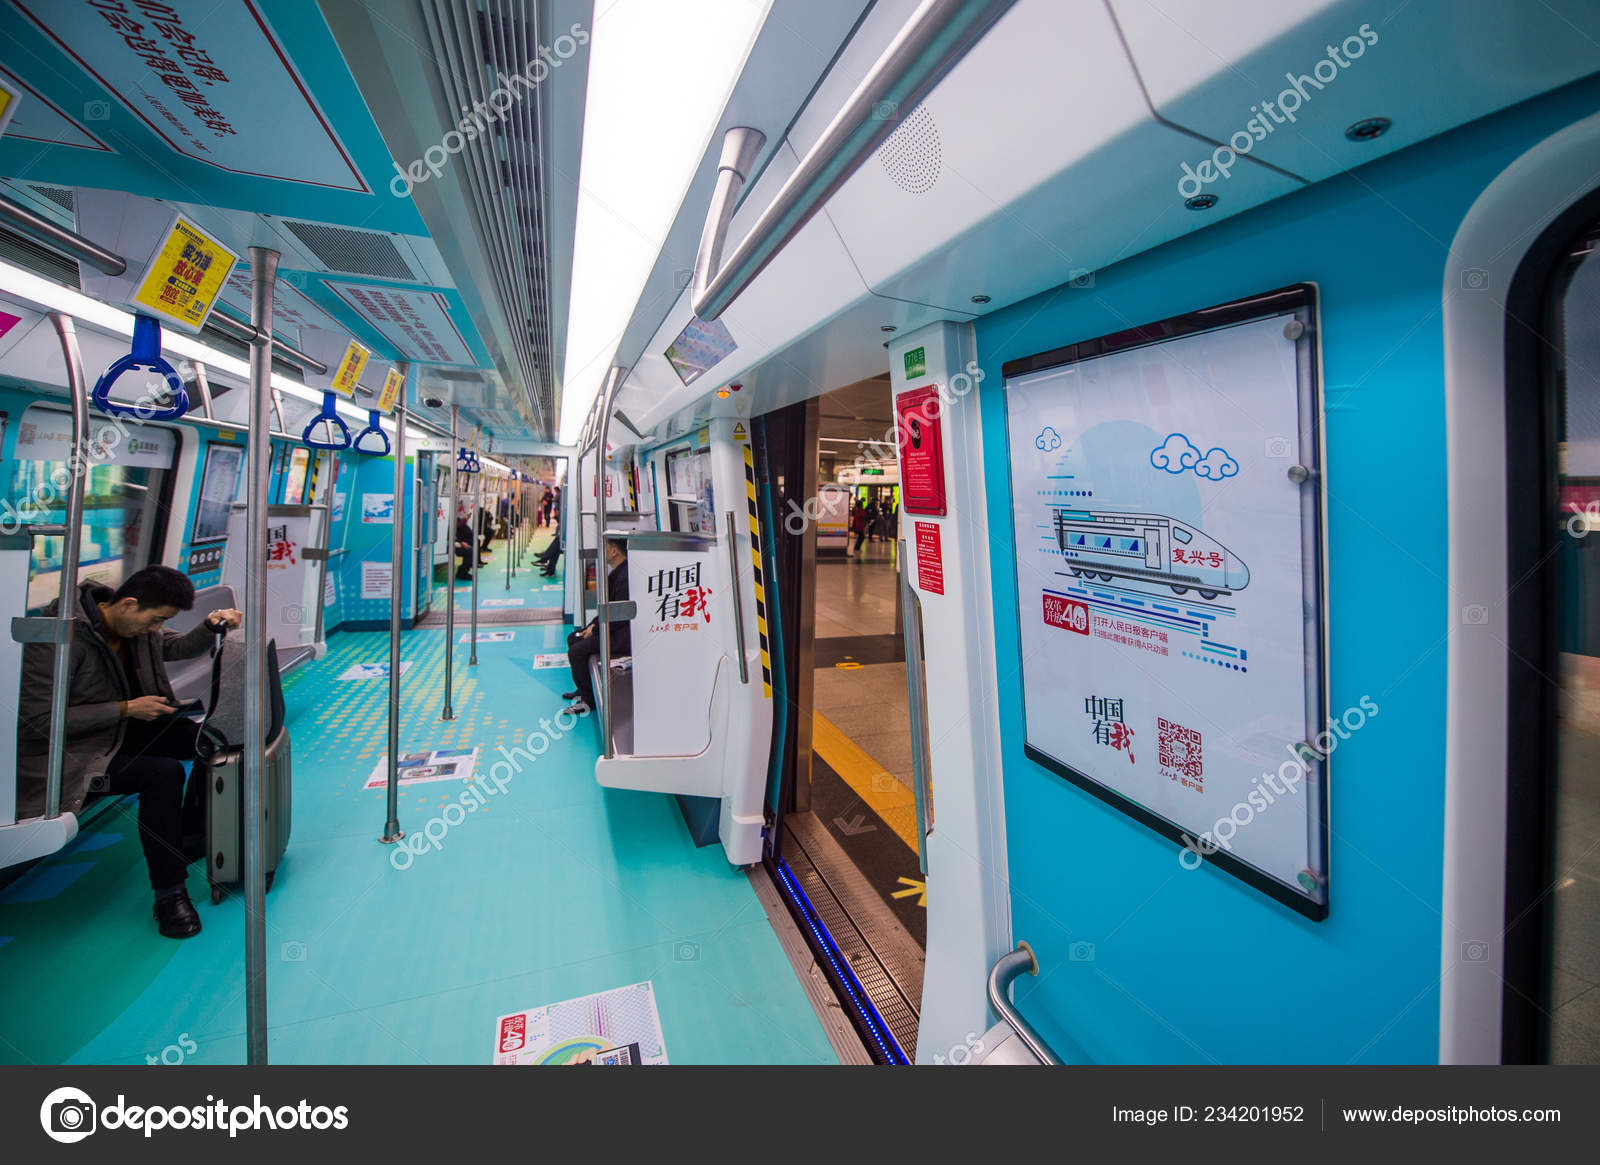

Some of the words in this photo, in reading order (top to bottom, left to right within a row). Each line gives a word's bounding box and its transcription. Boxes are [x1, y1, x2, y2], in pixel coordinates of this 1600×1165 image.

[1172, 548, 1224, 568] 复兴号
[647, 561, 702, 597] 中国
[656, 585, 713, 624] 有我
[1093, 615, 1169, 644] 打开人民日报客户端
[1085, 695, 1124, 724] 中国
[1092, 720, 1135, 765] 有我
